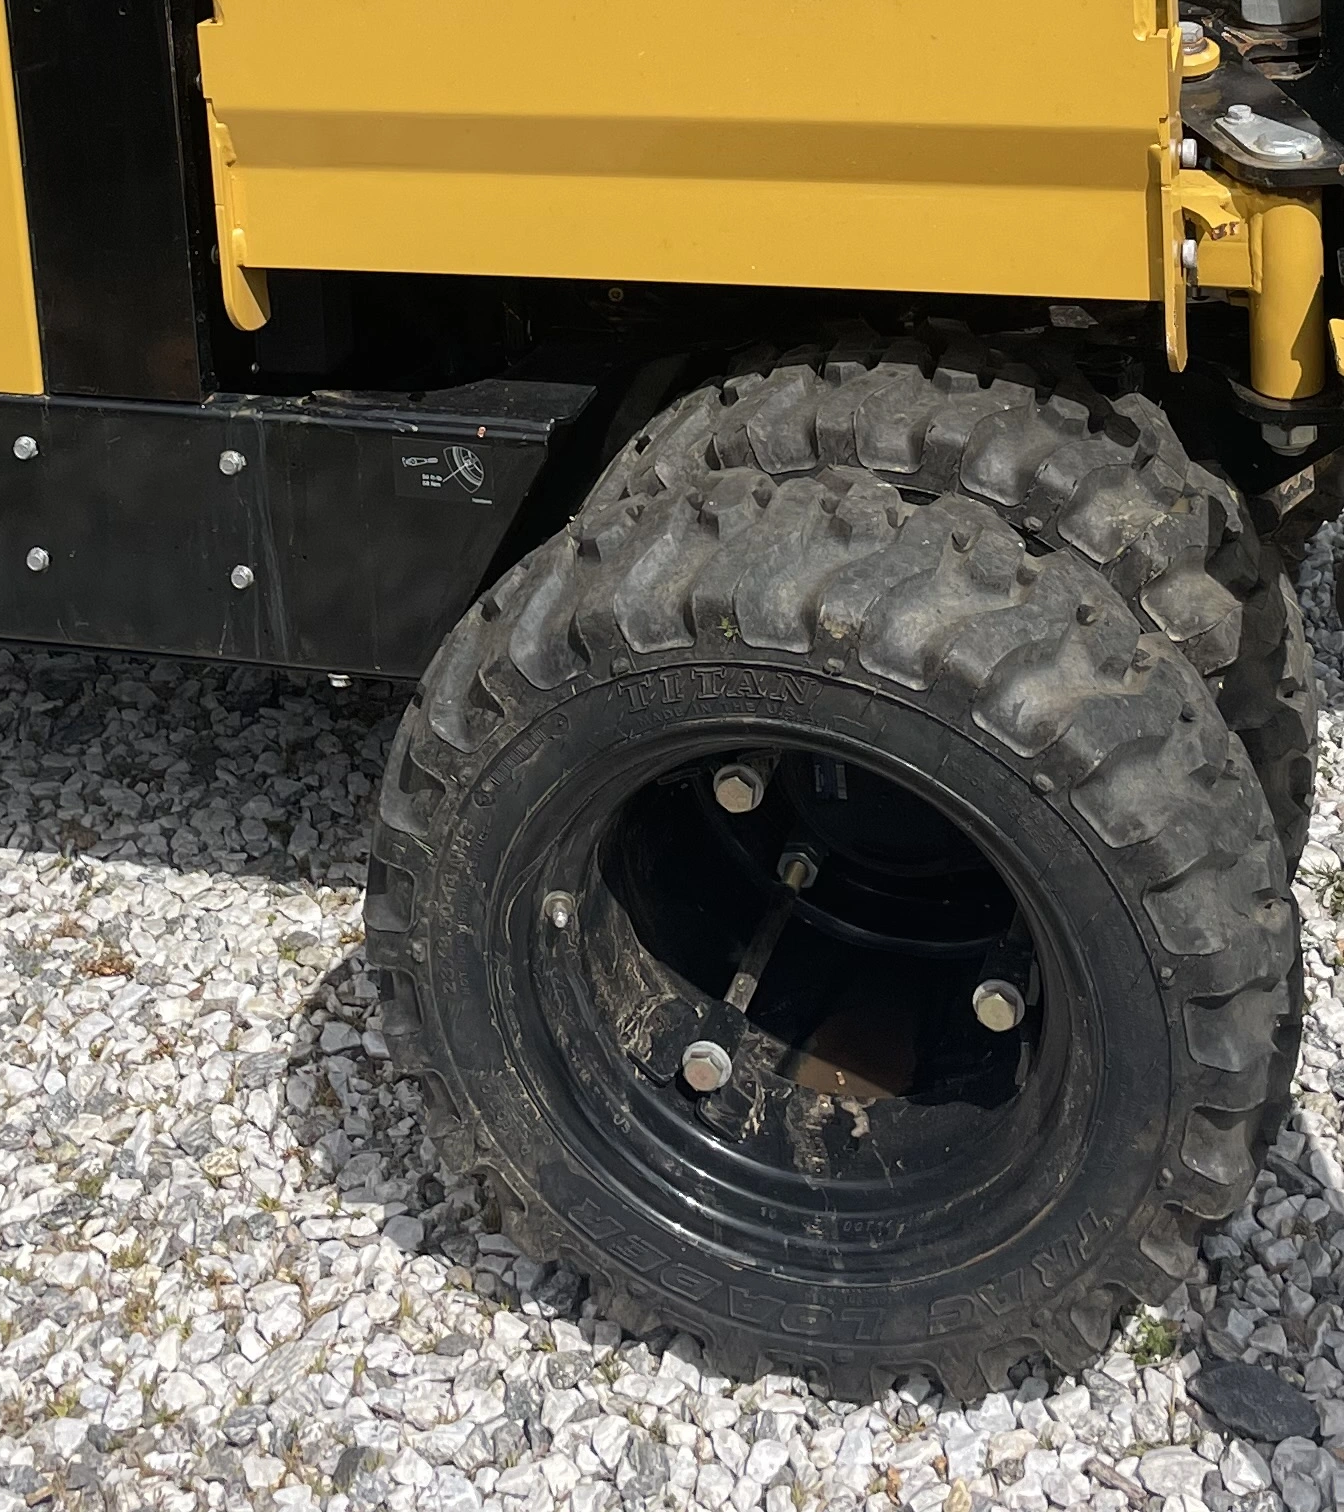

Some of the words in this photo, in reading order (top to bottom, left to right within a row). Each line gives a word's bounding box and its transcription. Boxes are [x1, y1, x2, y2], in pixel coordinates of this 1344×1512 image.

[617, 666, 819, 713] TITAN
[692, 701, 713, 714] IN
[720, 700, 757, 714] THE
[565, 1199, 877, 1341] LOADER
